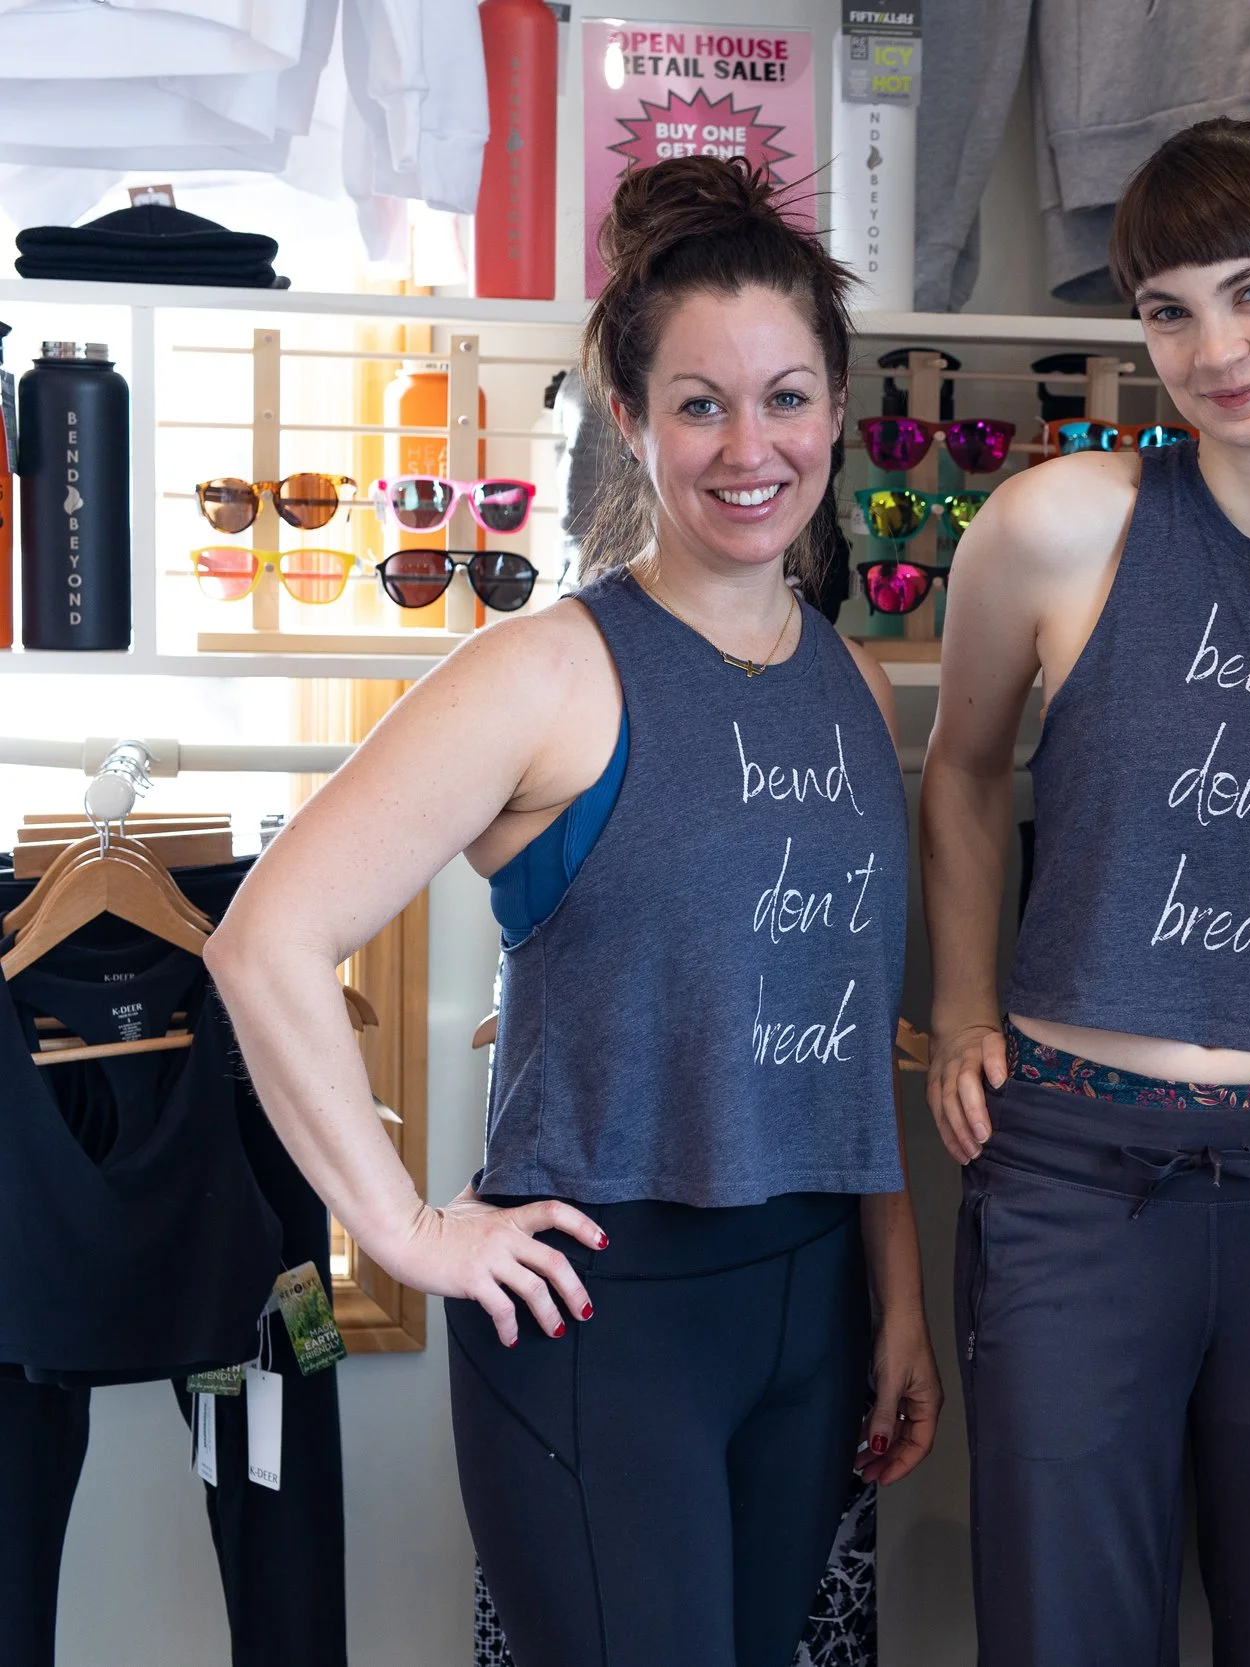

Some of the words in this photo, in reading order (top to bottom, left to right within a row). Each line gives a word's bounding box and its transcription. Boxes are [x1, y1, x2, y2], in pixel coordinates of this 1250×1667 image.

[608, 30, 685, 56] OPEN
[696, 33, 788, 60] HOUSE
[874, 47, 913, 67] ICY
[714, 59, 785, 82] SALE!
[872, 75, 912, 92] HOT
[655, 122, 698, 140] BUY
[702, 125, 747, 141] ONE
[656, 142, 697, 158] GET
[867, 174, 880, 273] BEYOND
[66, 411, 80, 483] BEND
[67, 517, 82, 626] BEYOND
[733, 721, 864, 816] bend
[753, 837, 883, 944] don't
[112, 1003, 143, 1016] K-DEER
[752, 974, 857, 1065] break
[304, 1328, 339, 1351] EARTH
[310, 1321, 335, 1337] MADE
[300, 1338, 340, 1363] FRIENDLY
[191, 1370, 239, 1382] RIENDLY
[249, 1466, 278, 1484] K-DEER
